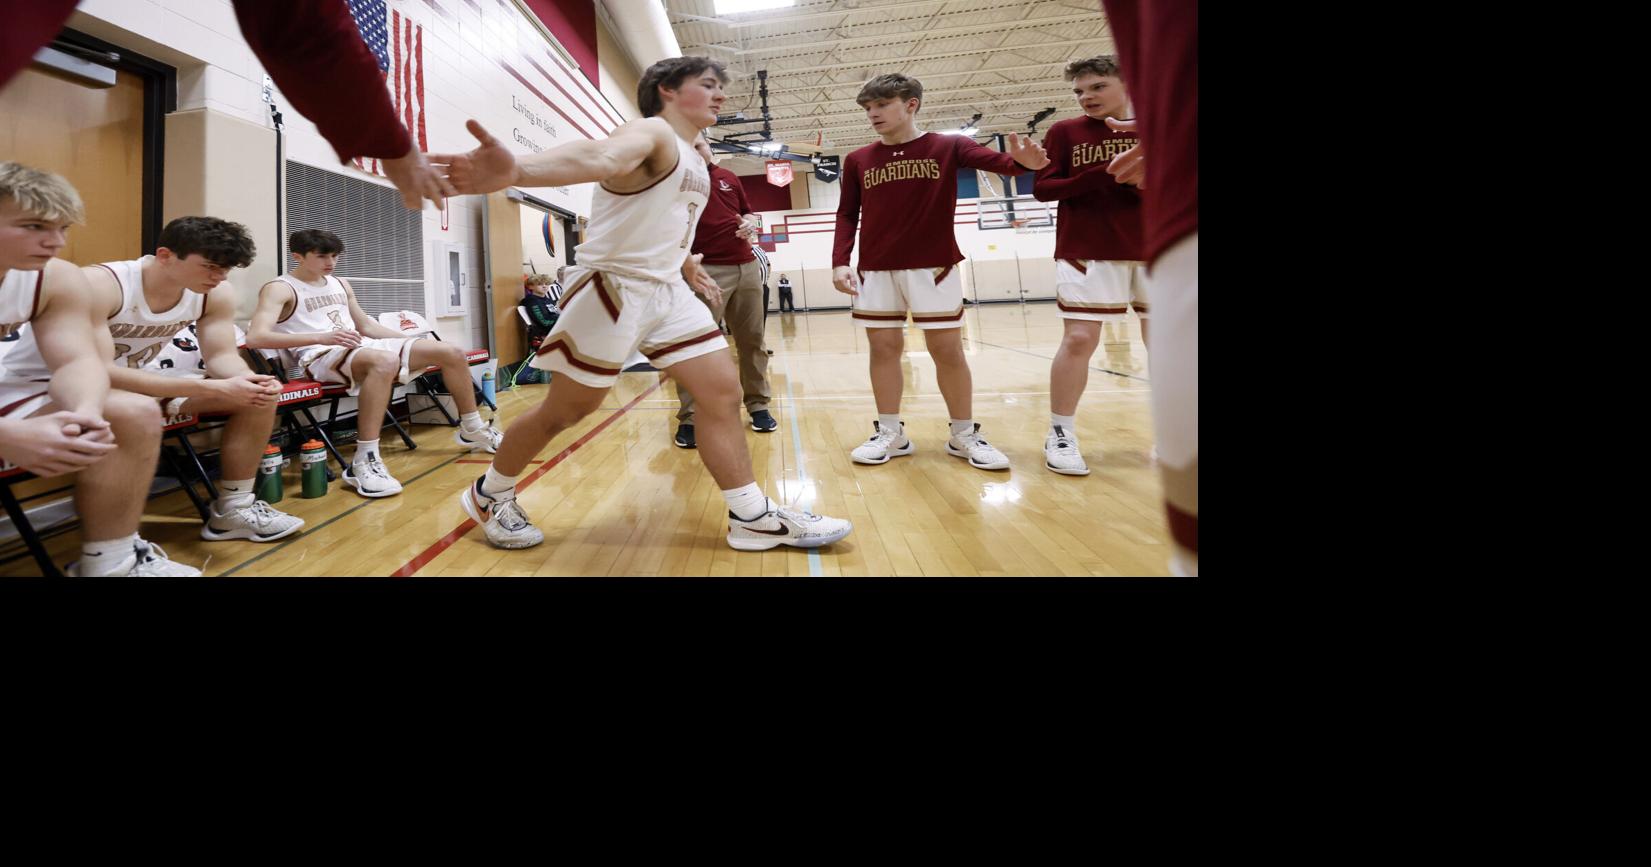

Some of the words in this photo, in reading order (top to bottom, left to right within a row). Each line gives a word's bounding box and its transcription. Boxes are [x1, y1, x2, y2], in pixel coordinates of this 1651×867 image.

[512, 94, 535, 126] Living
[863, 162, 941, 190] GUARDIANS
[886, 158, 937, 167] AMBROSE
